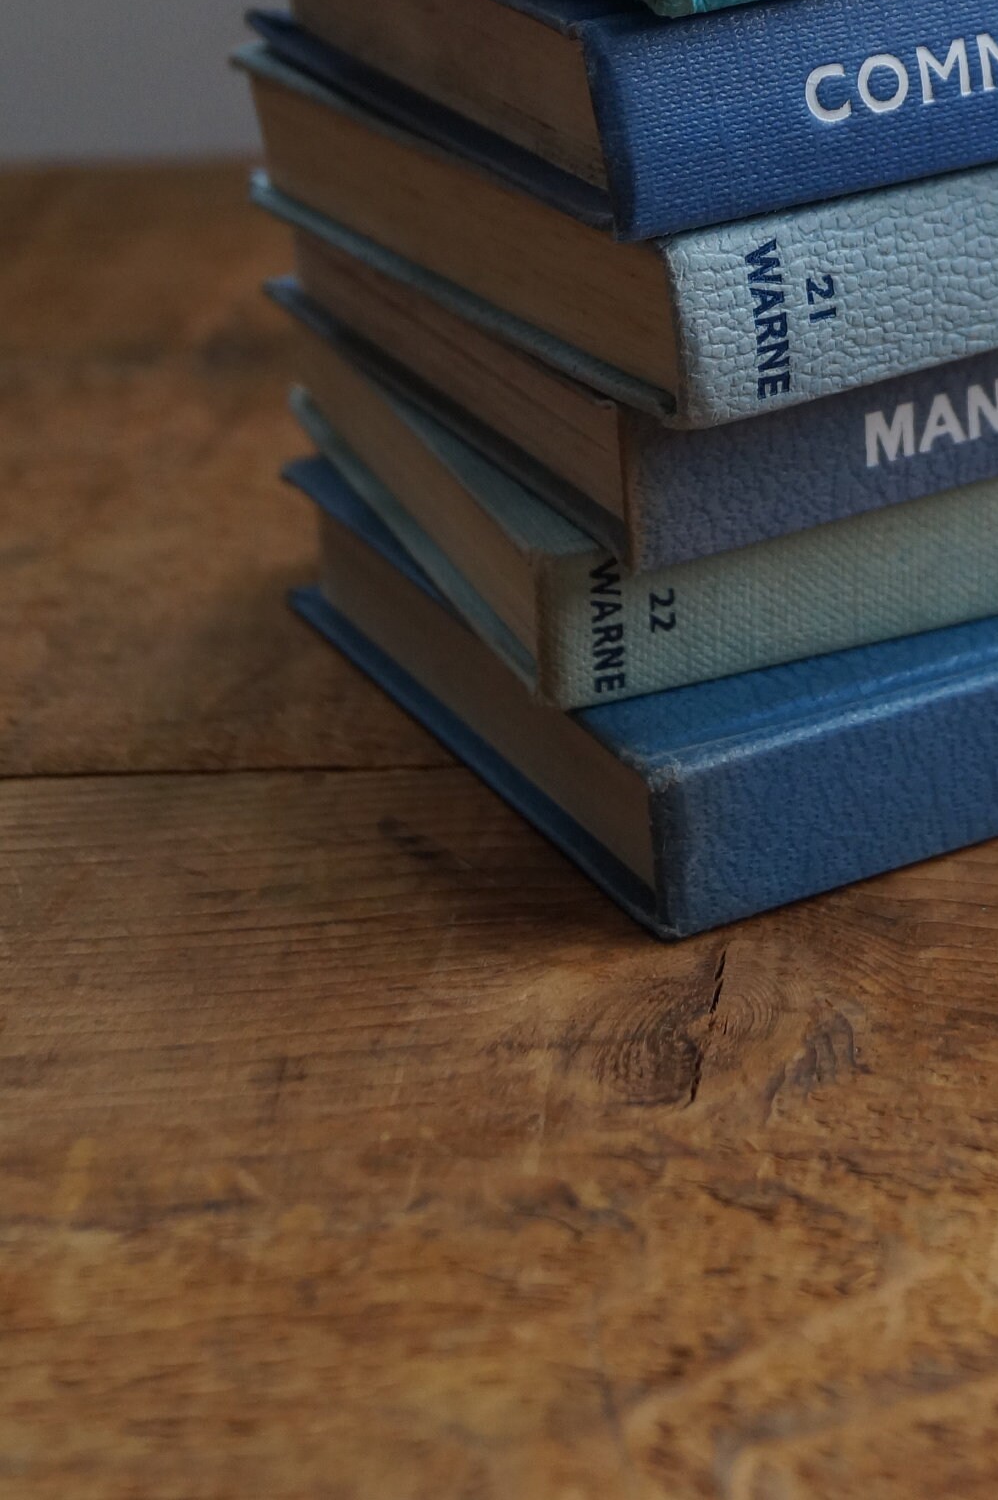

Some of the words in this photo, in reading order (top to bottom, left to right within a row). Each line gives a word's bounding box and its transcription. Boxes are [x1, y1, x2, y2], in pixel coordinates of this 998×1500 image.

[744, 238, 791, 400] WARNE
[805, 274, 837, 324] 21
[588, 556, 627, 694] WARNE
[648, 587, 677, 634] 22
